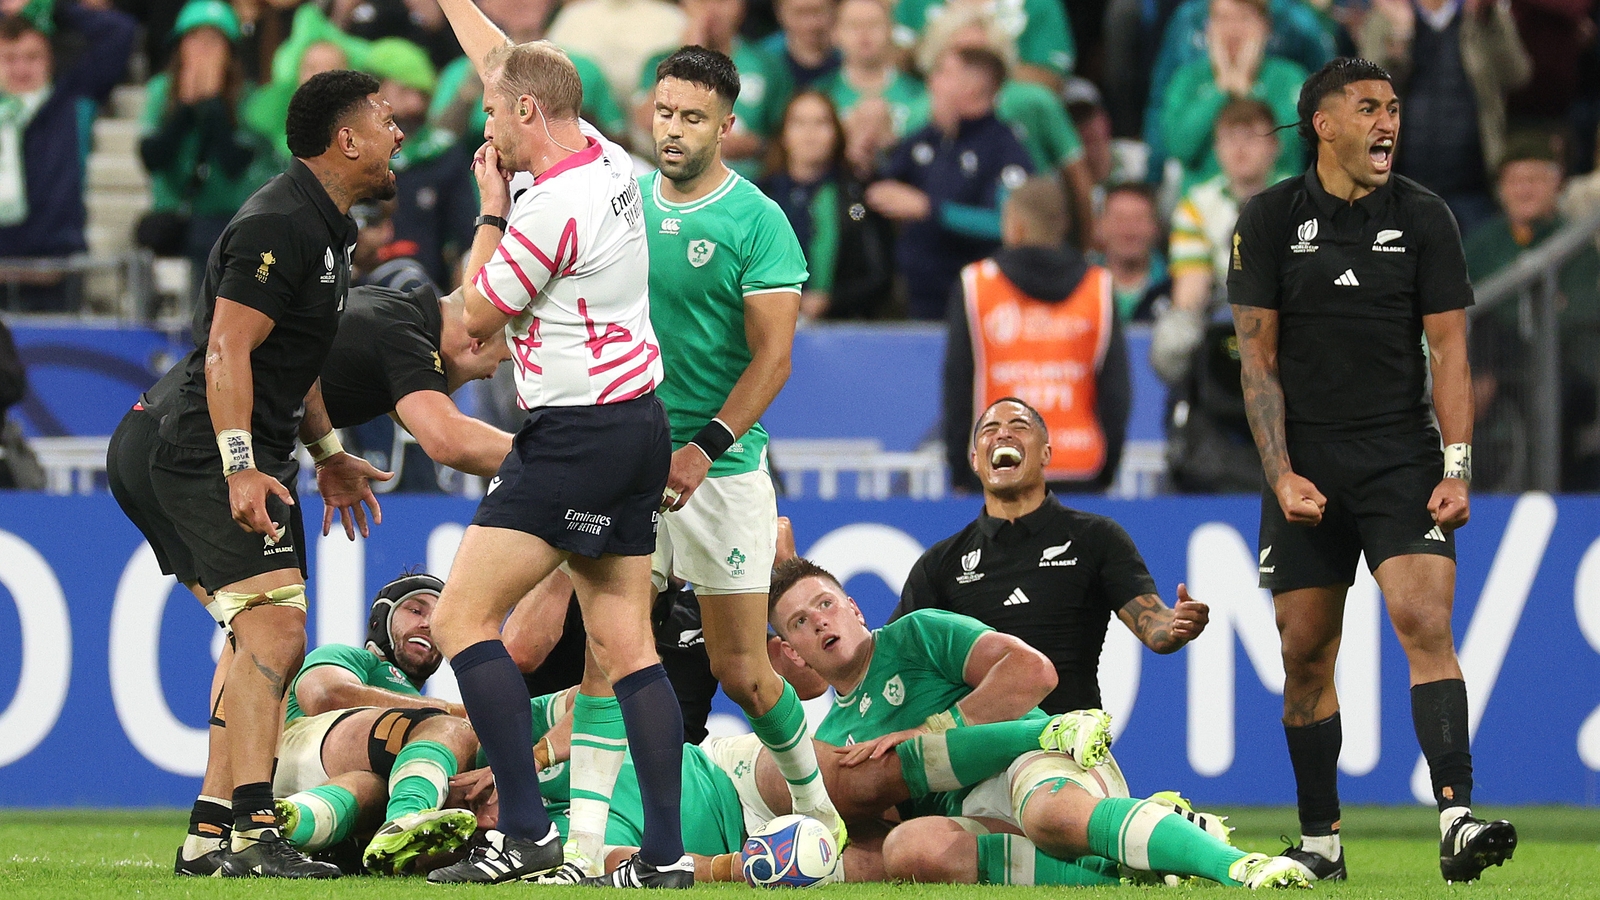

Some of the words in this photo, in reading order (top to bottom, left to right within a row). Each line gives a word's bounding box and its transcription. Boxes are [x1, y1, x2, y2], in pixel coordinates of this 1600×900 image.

[565, 509, 611, 527] Emirates
[566, 521, 578, 531] FLY
[577, 523, 602, 536] BETTER
[688, 637, 705, 647] BLAC
